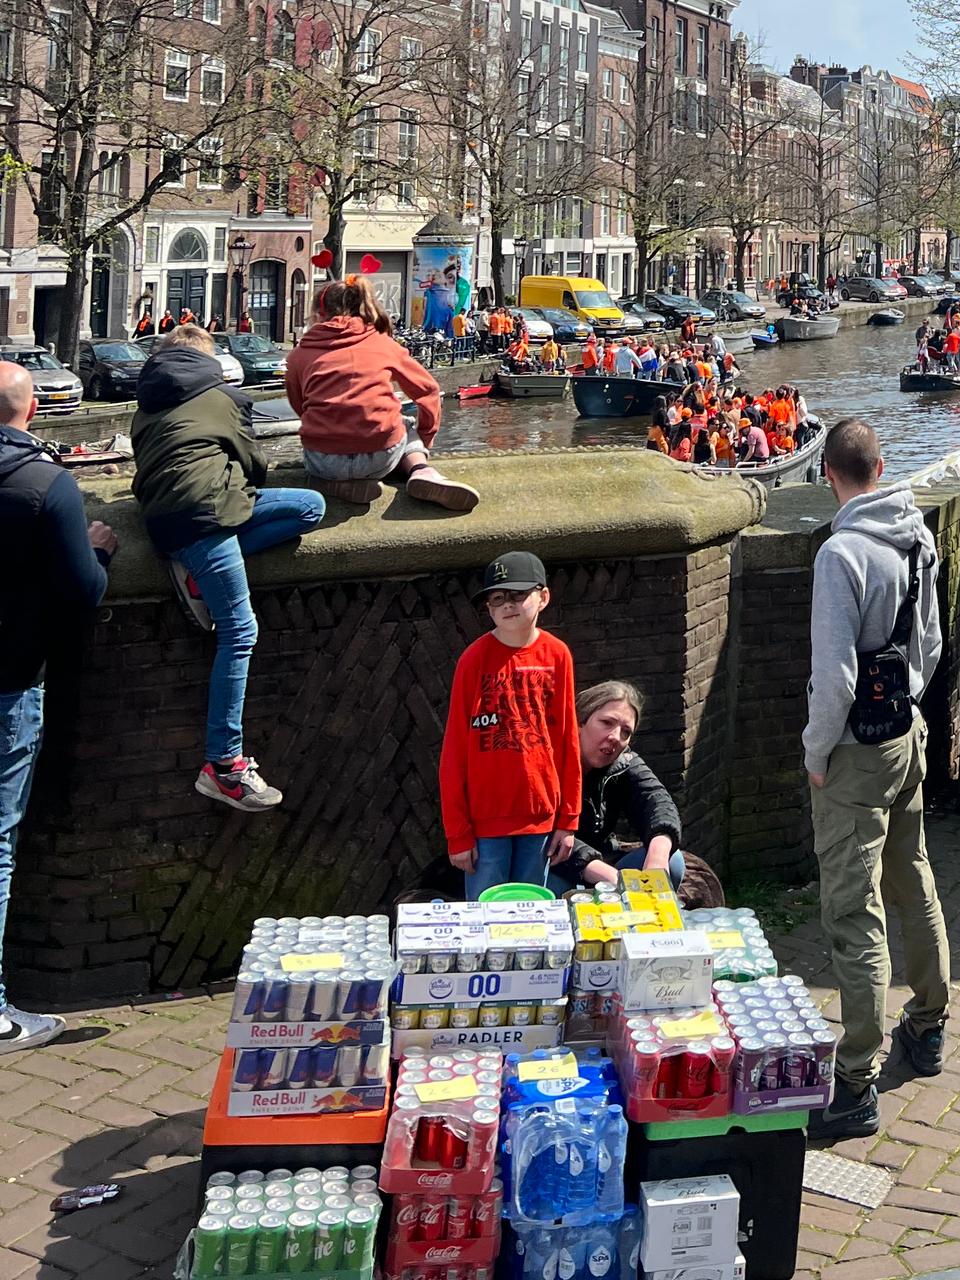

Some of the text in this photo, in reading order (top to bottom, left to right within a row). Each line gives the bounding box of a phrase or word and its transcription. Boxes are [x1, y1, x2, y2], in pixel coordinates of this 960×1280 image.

[472, 714, 498, 727] 404
[468, 974, 501, 998] 0.0
[656, 984, 686, 998] Bud
[251, 1024, 304, 1038] Red Bull
[458, 1031, 524, 1045] RADLER
[252, 1092, 306, 1106] Red Bull
